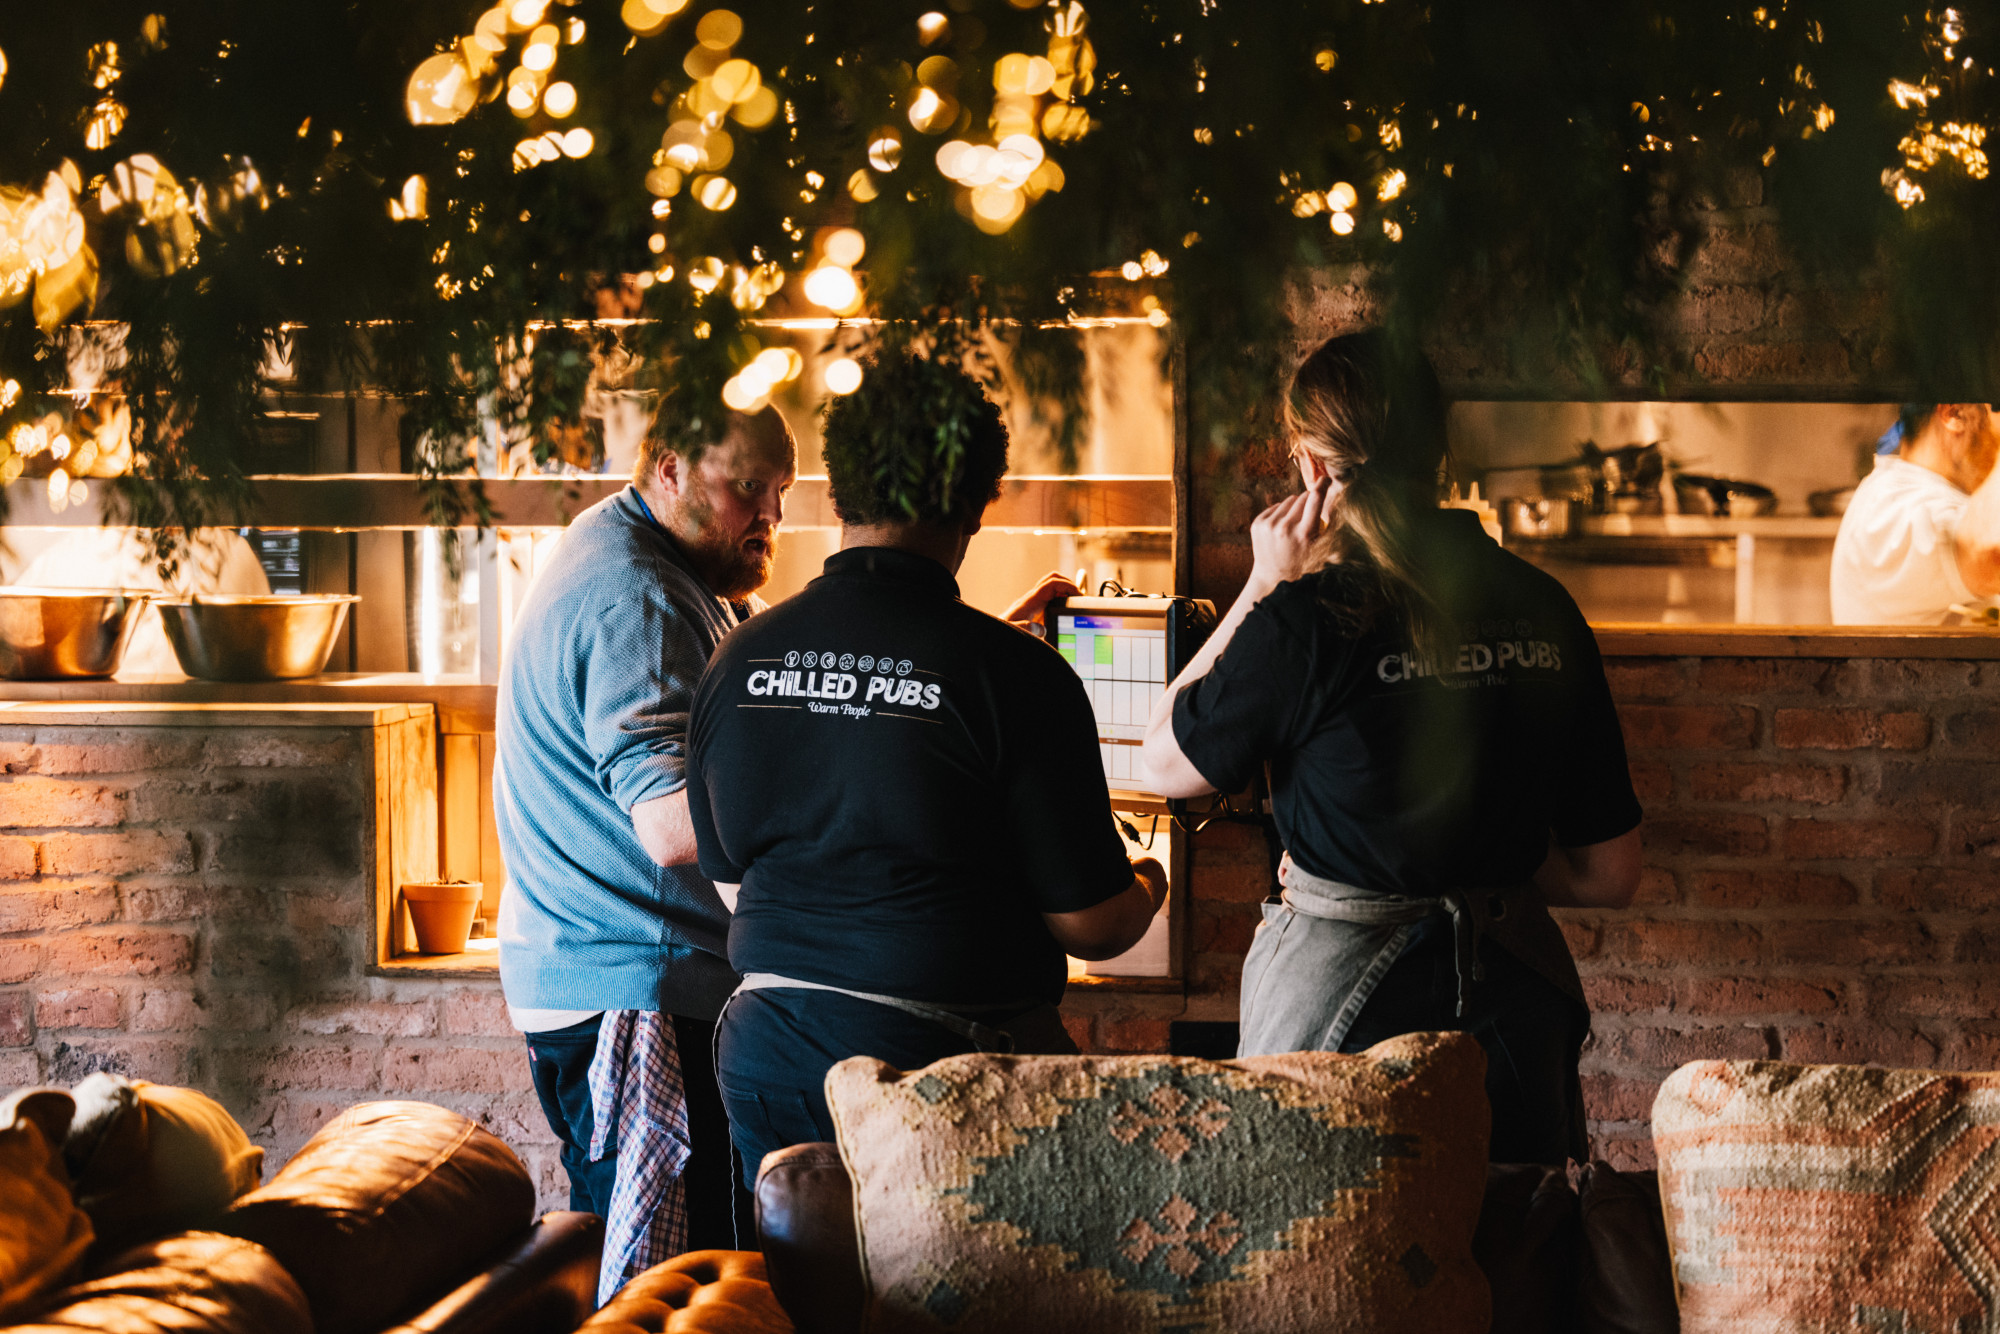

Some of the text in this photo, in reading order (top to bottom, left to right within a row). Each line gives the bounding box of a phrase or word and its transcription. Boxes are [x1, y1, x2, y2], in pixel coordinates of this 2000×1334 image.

[1377, 641, 1561, 683] CHIED PUBS
[747, 670, 941, 710] CHILLED PUBS
[807, 702, 871, 719] Warm People
